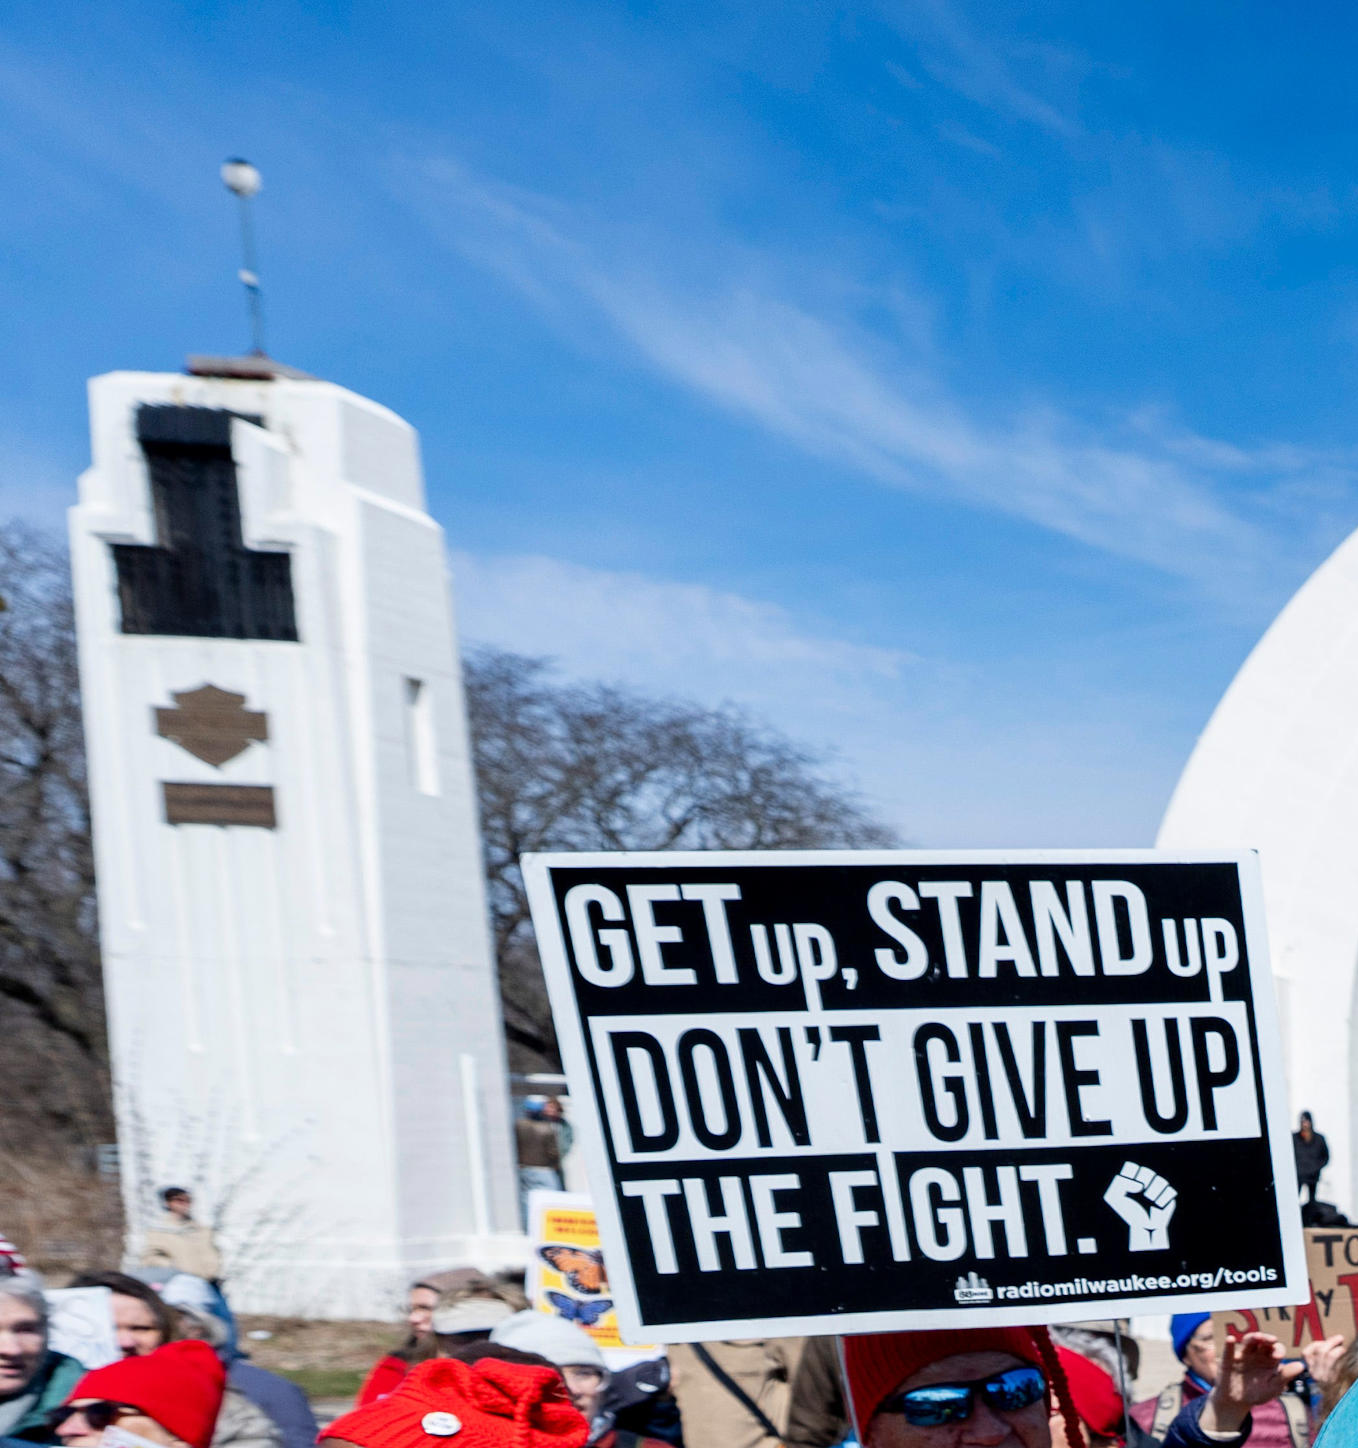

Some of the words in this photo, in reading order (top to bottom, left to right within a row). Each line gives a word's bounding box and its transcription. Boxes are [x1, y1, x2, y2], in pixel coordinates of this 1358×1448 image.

[564, 882, 742, 989] GET
[866, 879, 1154, 982] STAND
[609, 1024, 881, 1154] DON'T
[913, 1019, 1113, 1144] GIVE
[1131, 1015, 1241, 1135] UP
[622, 1172, 815, 1276] THE
[828, 1154, 1097, 1265] FIGHT.
[997, 1266, 1278, 1299] radiomilwaukee.org/tools
